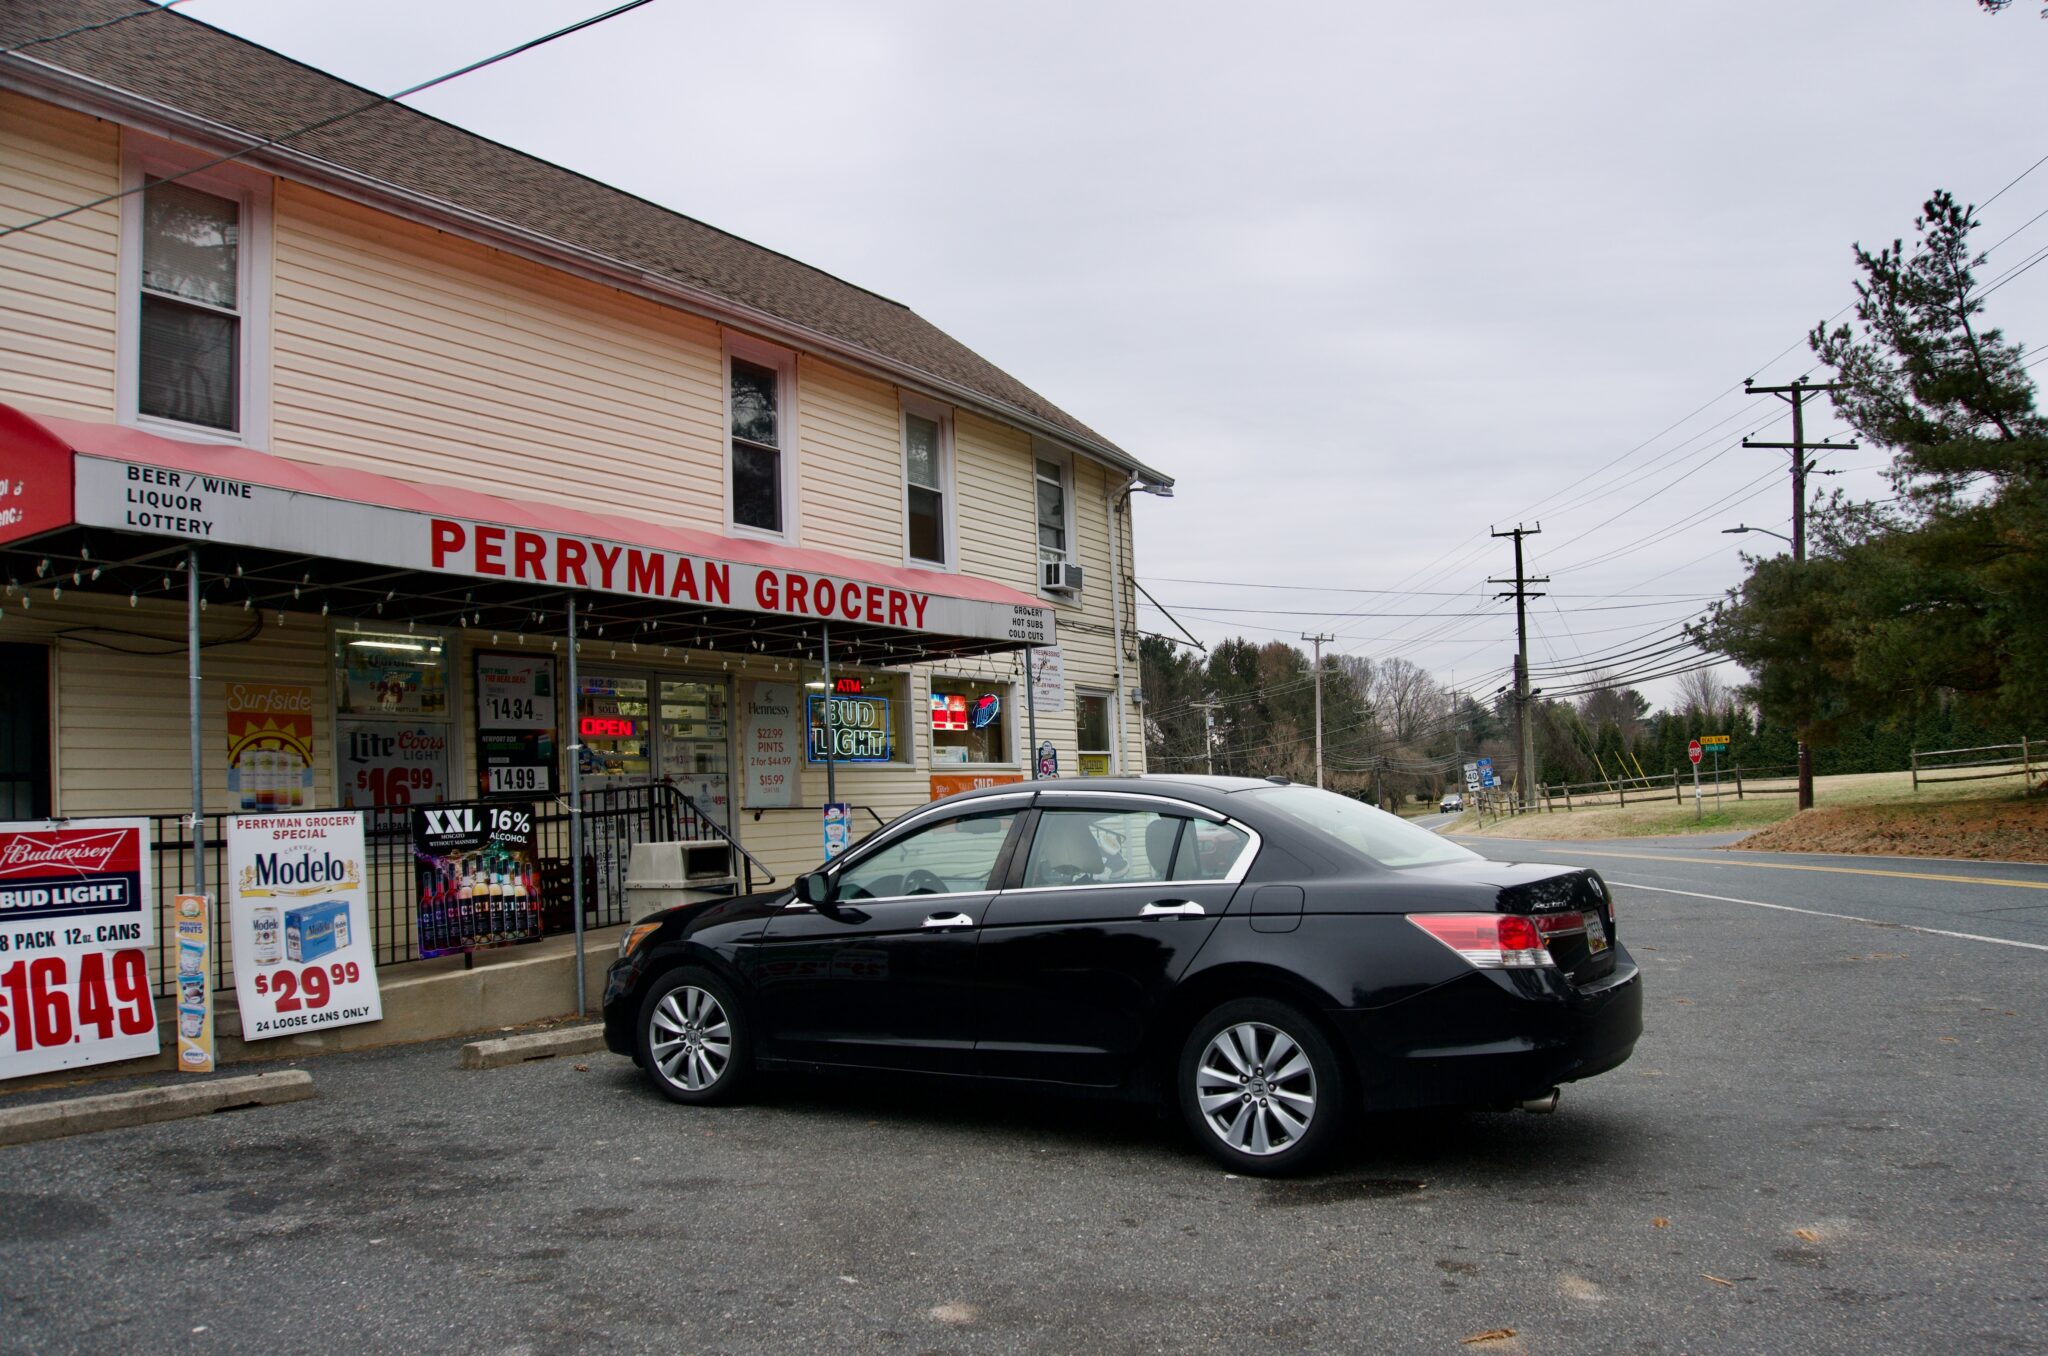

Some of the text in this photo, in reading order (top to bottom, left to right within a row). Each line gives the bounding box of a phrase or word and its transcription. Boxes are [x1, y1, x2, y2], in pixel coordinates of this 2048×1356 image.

[127, 466, 180, 487] BEER
[202, 478, 251, 499] WINE
[127, 488, 202, 512] LIQUOR
[127, 510, 213, 535] LOTTERY
[431, 518, 929, 630] PERRYMAN GROCERY
[1012, 617, 1043, 629] HOT SUBS
[1008, 629, 1044, 641] COLD CUTS
[836, 678, 860, 693] ATM
[227, 684, 312, 713] Surfside
[486, 698, 533, 720] $14.34
[748, 702, 790, 718] Hennessy
[824, 699, 875, 727] BUD
[581, 718, 632, 736] OPEN
[757, 728, 783, 739] $22.99
[349, 729, 445, 764] Lite Coors
[758, 742, 784, 753] PINTS
[815, 728, 884, 756] LIGHT
[403, 750, 440, 761] LIGHT
[768, 756, 791, 766] $44.99
[1689, 747, 1701, 757] STOP
[489, 768, 535, 790] $14.99
[759, 774, 784, 786] $15.99
[1467, 773, 1477, 781] 40
[237, 816, 356, 829] PERRYMAN GROCERY
[424, 808, 530, 835] XXL 16%
[273, 829, 327, 840] SPECIAL
[489, 832, 527, 844] ALCOHOL
[4, 843, 113, 863] Budweiser
[284, 845, 317, 854] CERVEZA
[255, 852, 344, 886] Modelo
[0, 884, 123, 909] BUD LIGHT
[15, 930, 56, 950] PACK
[97, 923, 141, 943] CANS
[179, 926, 203, 934] PINTS
[256, 1006, 370, 1032] 24 LOOSE CANS ONLY
